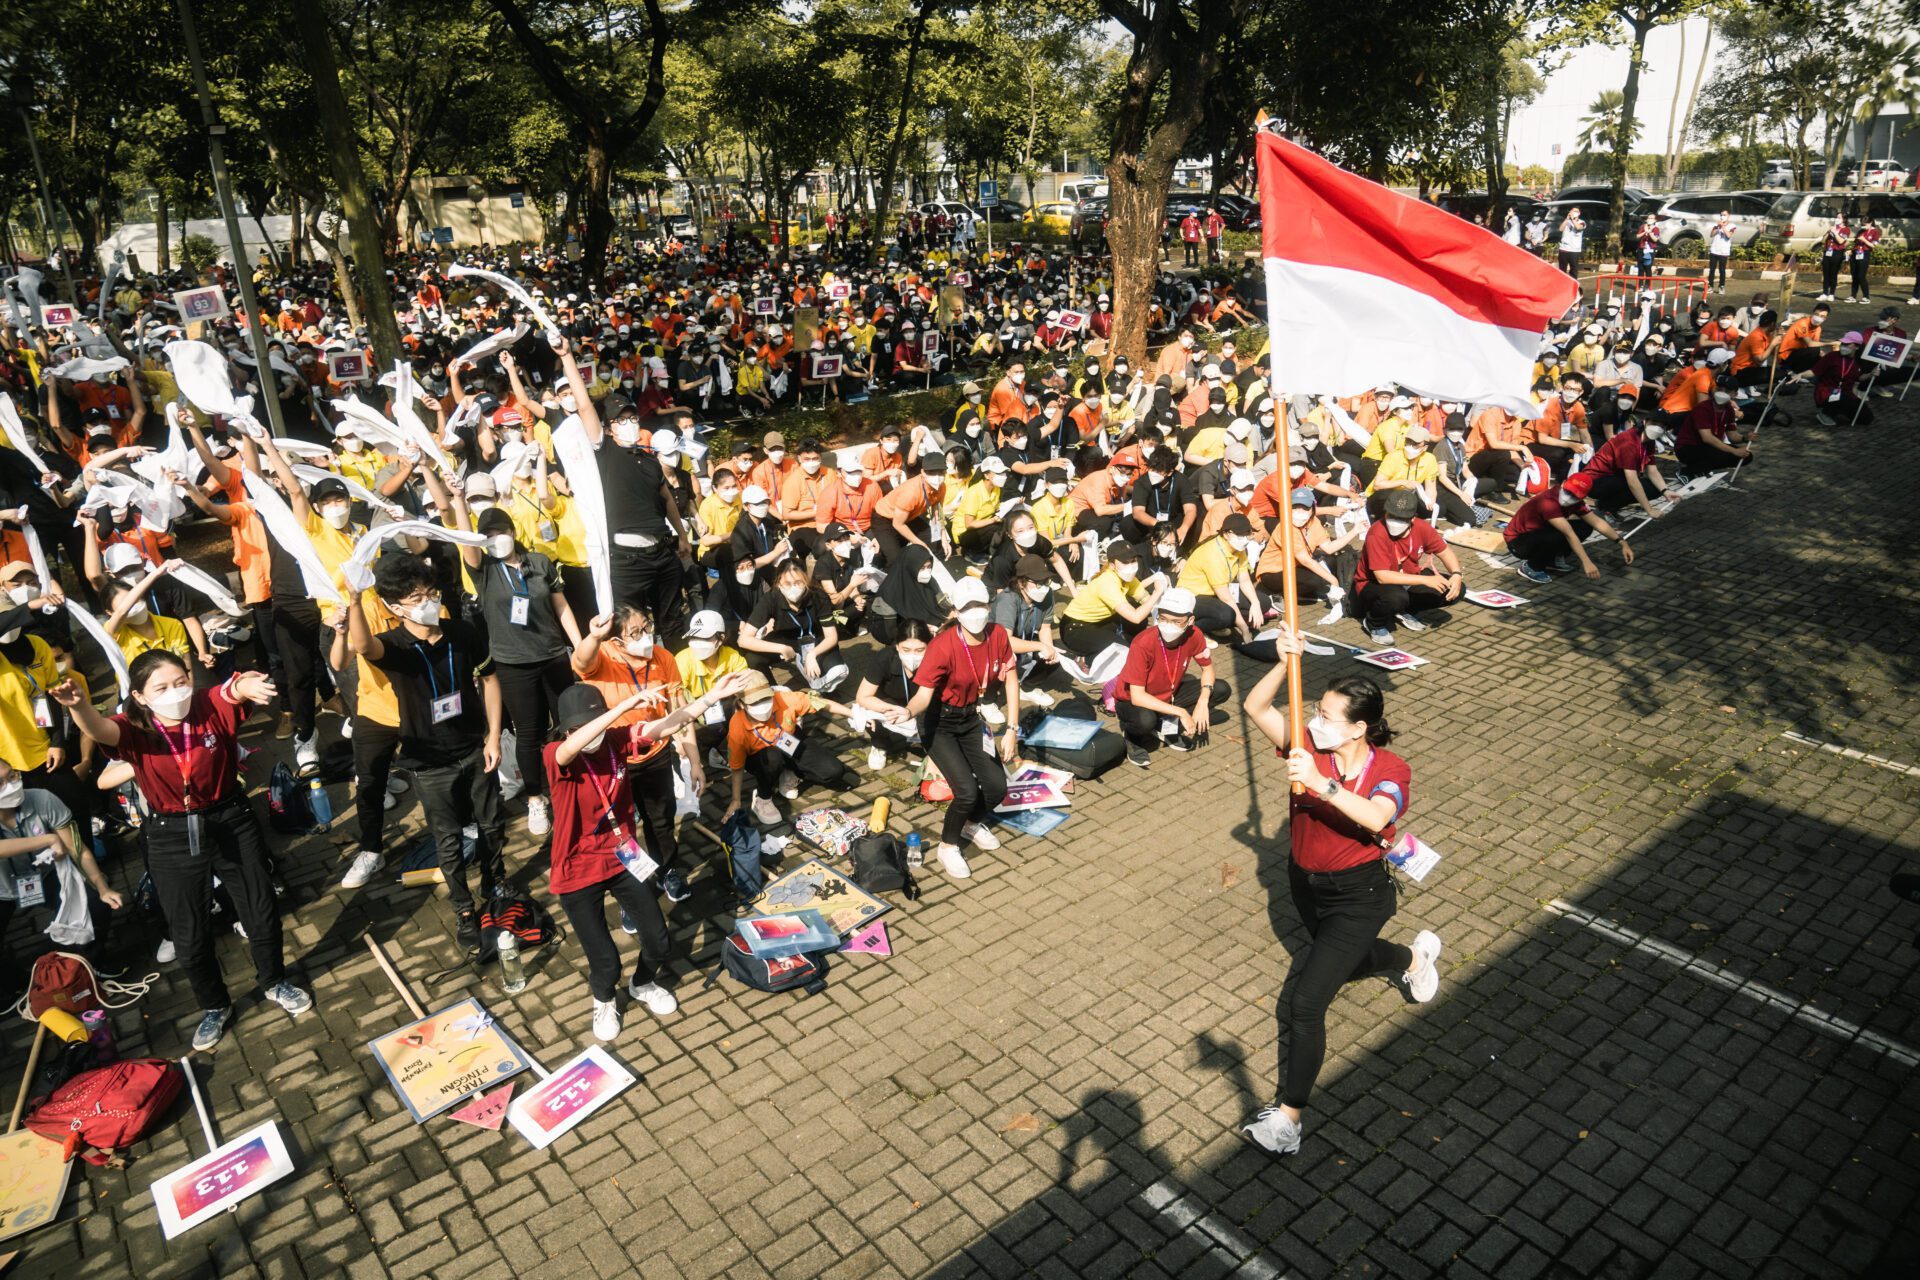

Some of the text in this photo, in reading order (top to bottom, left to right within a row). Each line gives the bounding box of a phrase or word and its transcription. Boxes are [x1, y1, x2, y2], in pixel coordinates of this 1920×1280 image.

[194, 299, 209, 309] 93
[52, 312, 65, 320] 74
[1877, 344, 1897, 356] 105
[343, 361, 355, 371] 92
[1009, 790, 1042, 800] 110
[439, 1064, 489, 1095] PINGGAN
[455, 1077, 488, 1096] TARI
[545, 1077, 591, 1111] 112
[195, 1159, 249, 1196] 113
